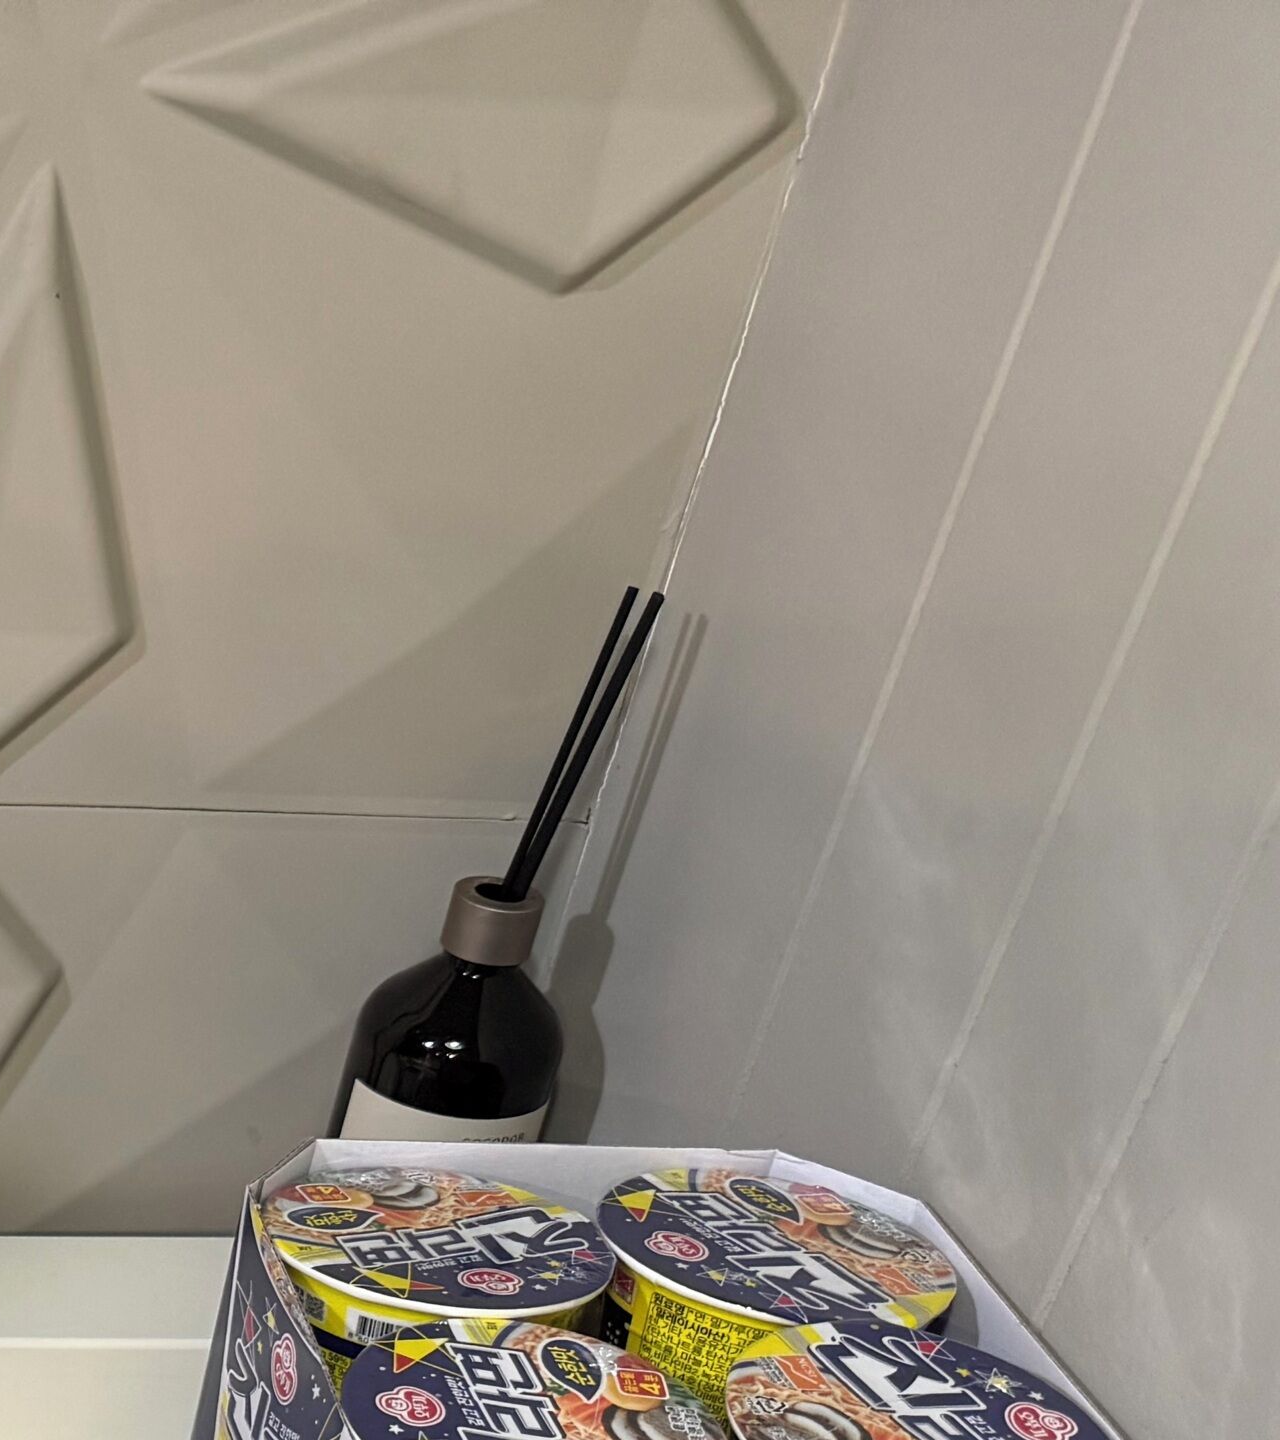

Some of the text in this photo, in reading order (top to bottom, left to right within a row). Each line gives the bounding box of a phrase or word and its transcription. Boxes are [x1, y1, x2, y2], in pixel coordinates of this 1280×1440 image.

[334, 1206, 589, 1267] 진라면
[655, 1190, 896, 1312] 진라면
[555, 1345, 596, 1387] 순한맛
